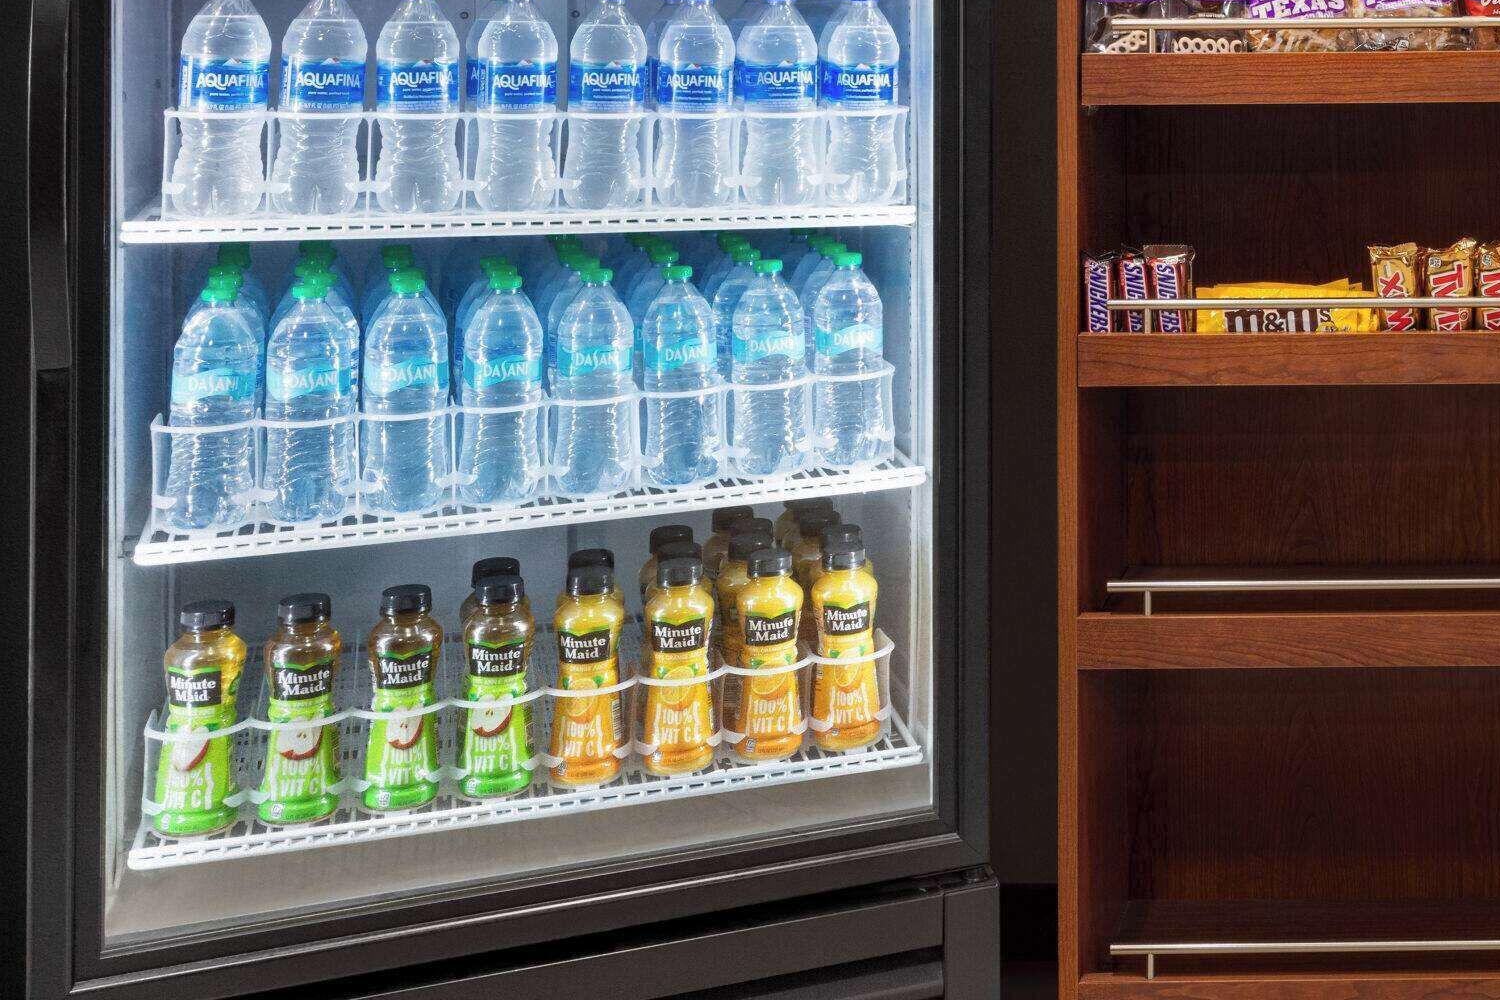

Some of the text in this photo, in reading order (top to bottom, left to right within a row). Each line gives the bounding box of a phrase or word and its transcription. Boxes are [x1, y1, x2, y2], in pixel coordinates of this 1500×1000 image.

[196, 72, 264, 90] AQUAFINA
[295, 71, 360, 89] AQUAFINA
[390, 70, 453, 87] AQUAFINA
[492, 73, 552, 90] AQUAFINA
[582, 72, 641, 88] AQUAFINA
[666, 75, 724, 90] AQUAFINA
[757, 70, 813, 86] AQUAFINA
[837, 73, 891, 88] AQUAFINA
[388, 363, 435, 386] DASANI
[826, 608, 867, 621] Minute
[749, 617, 794, 631] Minute
[832, 620, 863, 631] Maid
[655, 625, 702, 639] Minute
[755, 630, 789, 642] Maid
[561, 636, 606, 649] Minute
[660, 637, 696, 649] Maid
[472, 649, 520, 661] Minute
[565, 648, 600, 660] Maid
[381, 660, 429, 673] Minute
[477, 660, 514, 672] Maid
[171, 676, 216, 689] Minute
[279, 669, 330, 685] Minute
[386, 673, 422, 685] Maid
[175, 689, 210, 701] Maid
[284, 683, 324, 696] Maid
[837, 690, 863, 706] 100%
[753, 697, 787, 714] 100%
[836, 706, 865, 724] VIT C
[752, 716, 785, 733] VIT C
